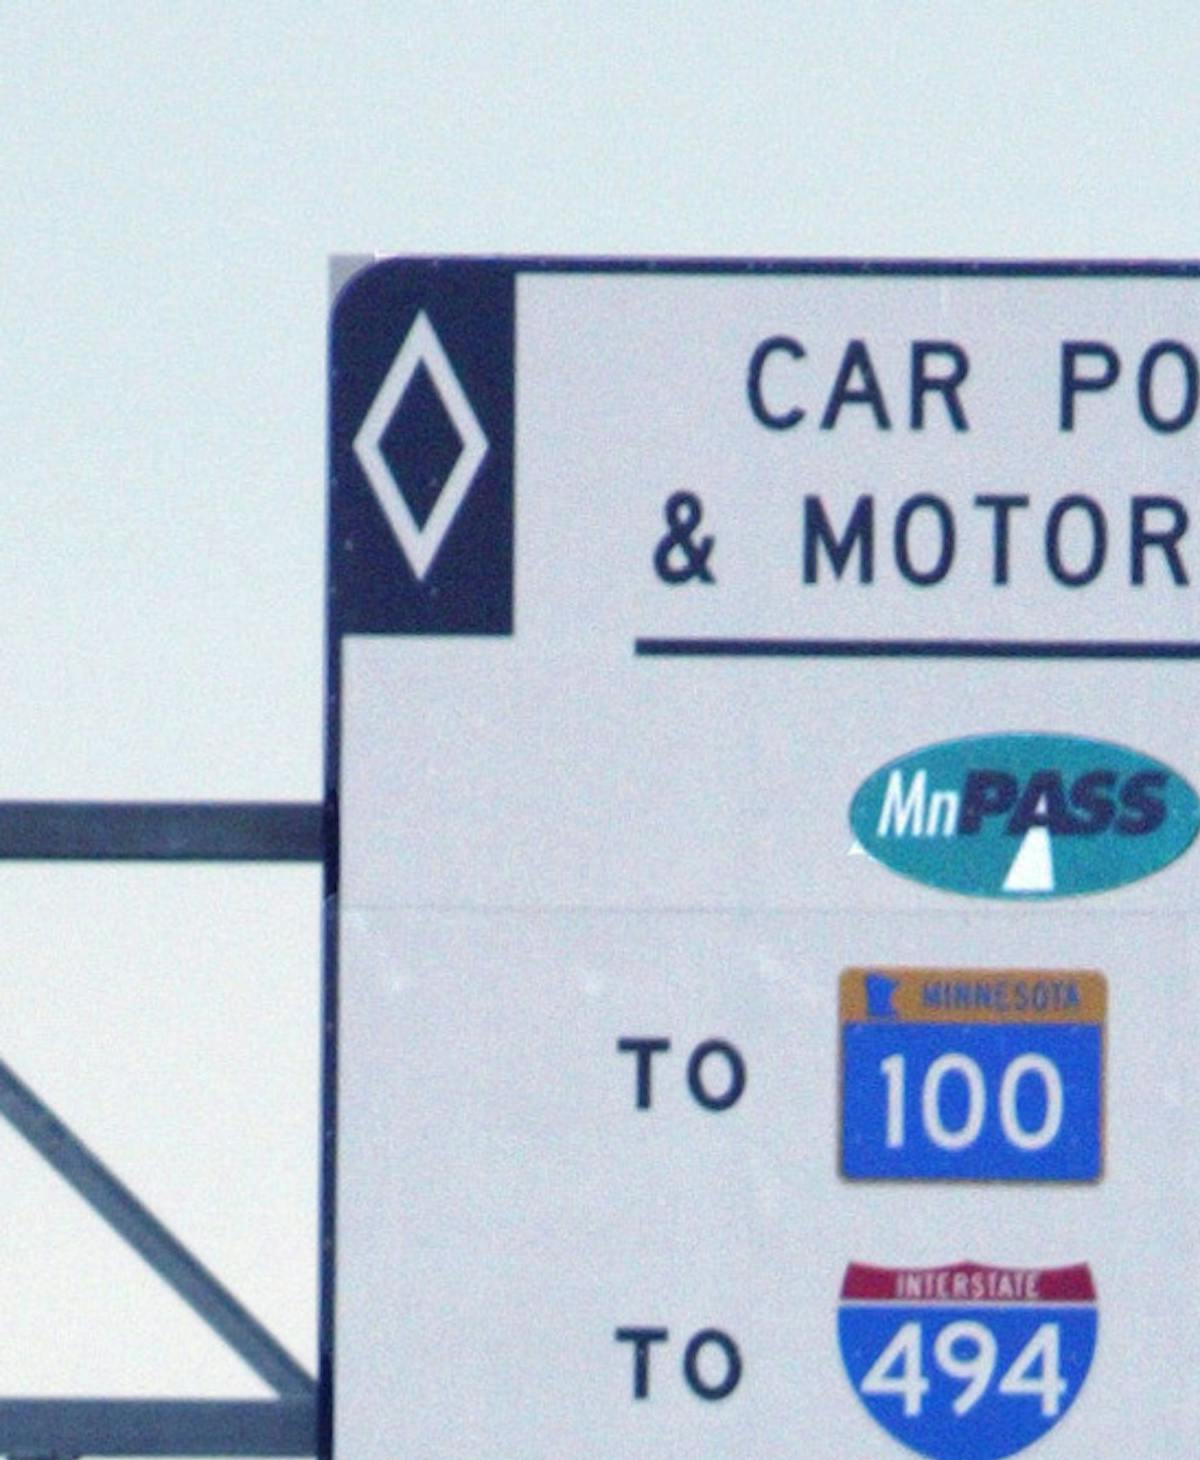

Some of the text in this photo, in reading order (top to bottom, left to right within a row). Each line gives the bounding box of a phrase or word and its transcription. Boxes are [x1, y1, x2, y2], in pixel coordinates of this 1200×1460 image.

[745, 335, 971, 433] CAR
[652, 490, 716, 587] &
[876, 768, 1170, 837] MnPASS
[923, 979, 1080, 1012] MINNESOTA
[616, 1037, 1065, 1151] TO 100
[897, 1270, 1040, 1298] INTERSTATE
[614, 1318, 1068, 1418] TO 494
